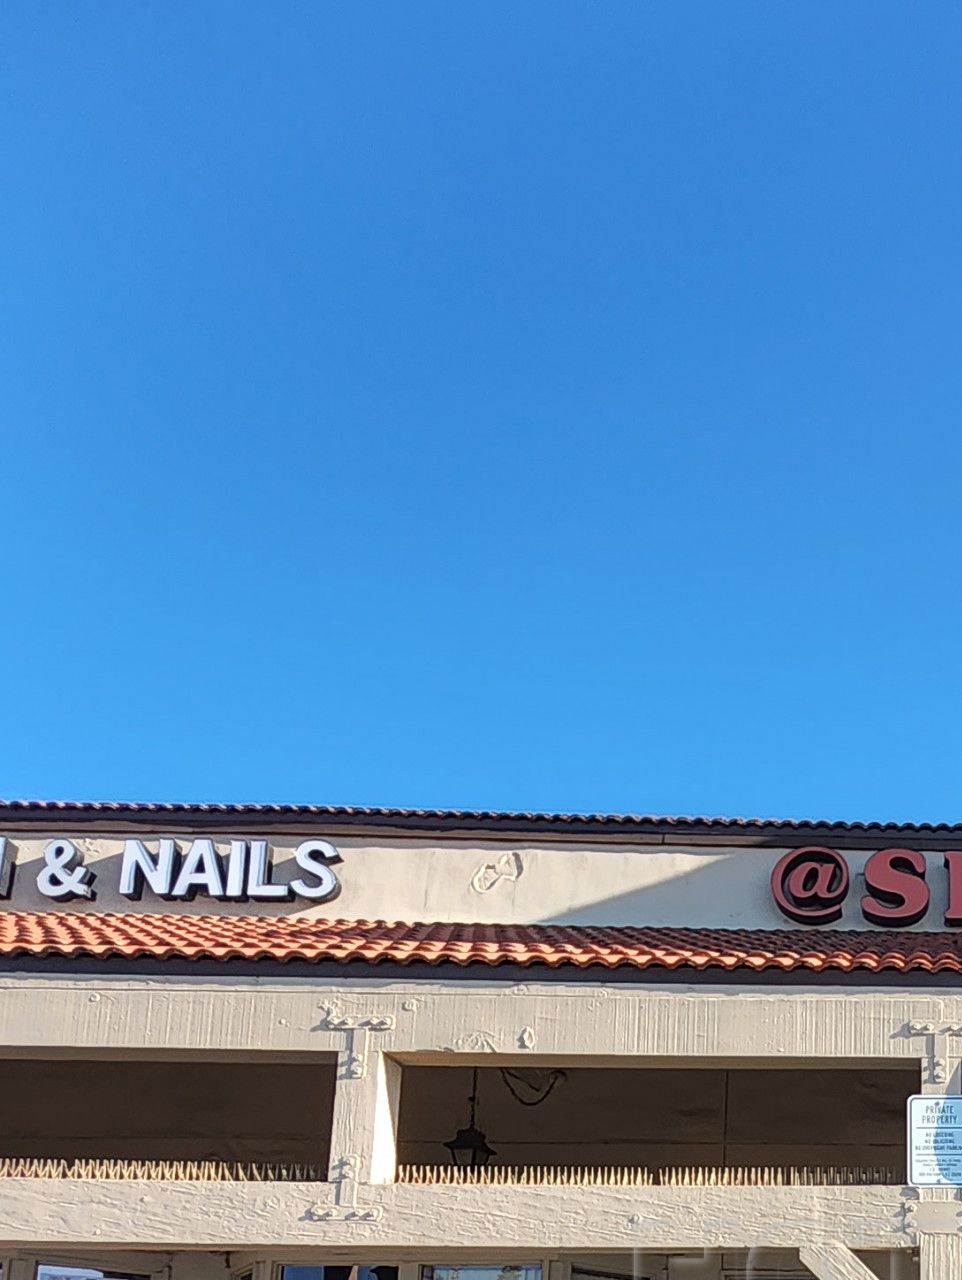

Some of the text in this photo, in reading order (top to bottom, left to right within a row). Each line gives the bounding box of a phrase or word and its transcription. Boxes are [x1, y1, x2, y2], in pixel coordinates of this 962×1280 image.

[37, 838, 94, 898] &
[119, 838, 342, 899] NAILS
[925, 1105, 955, 1114] PRIVATE
[921, 1115, 958, 1124] PROPERTY
